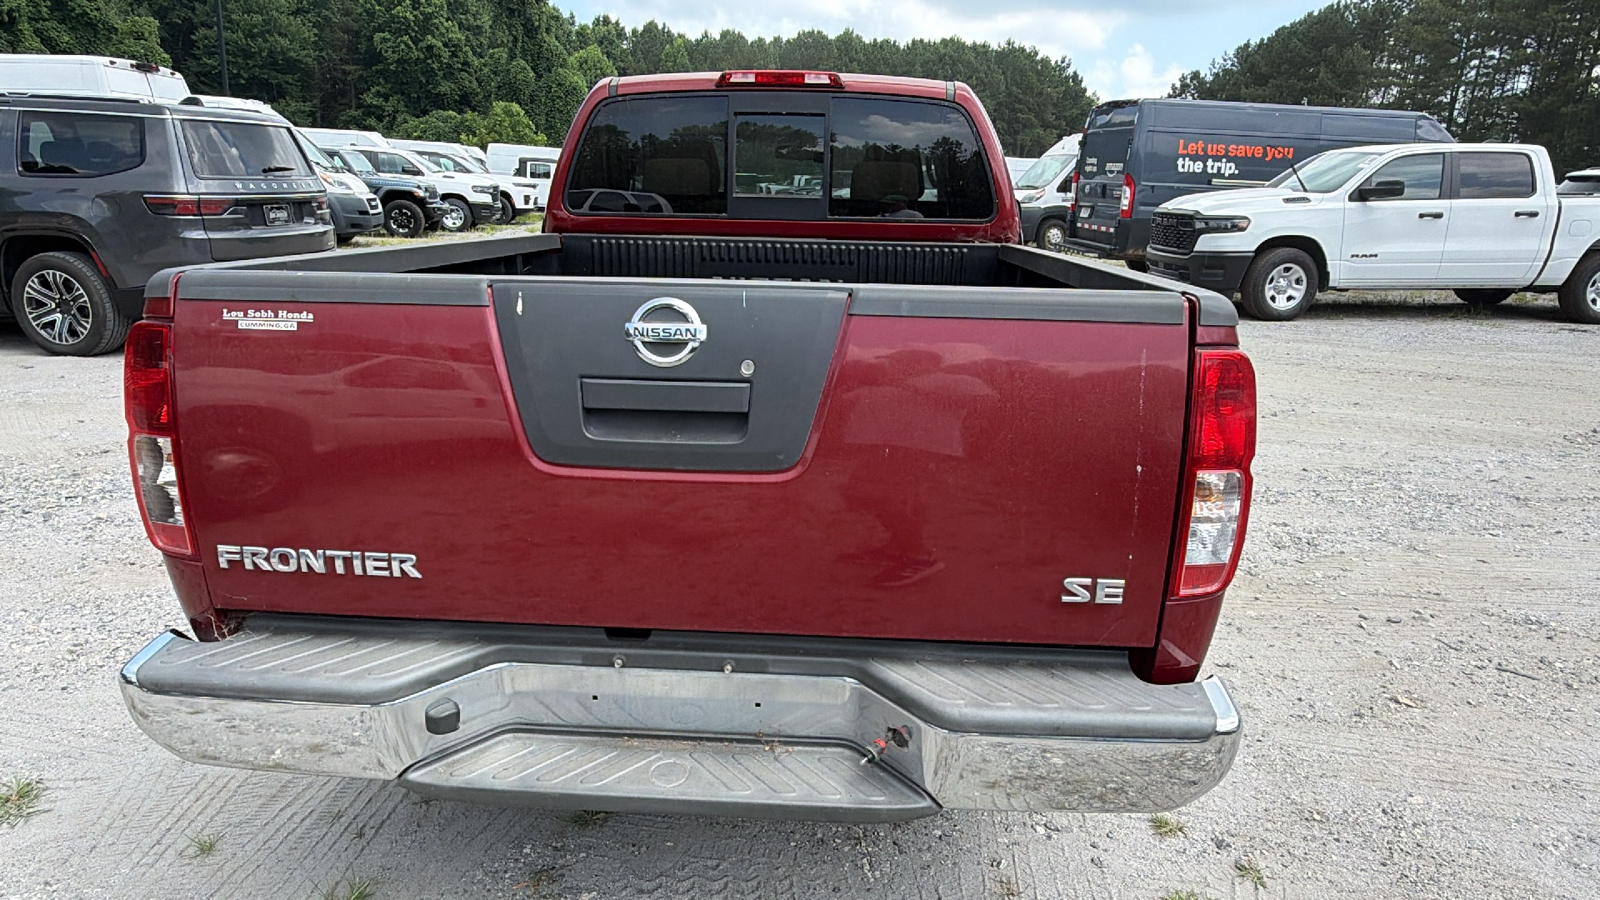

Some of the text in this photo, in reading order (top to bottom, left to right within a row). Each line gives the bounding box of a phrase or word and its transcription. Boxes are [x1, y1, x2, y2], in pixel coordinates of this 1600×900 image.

[1178, 139, 1293, 161] Let us save you
[1177, 157, 1239, 177] the trip.
[222, 308, 314, 319] Lou Sobh Honda
[633, 326, 698, 338] NISSAN
[217, 544, 422, 579] FRONTIER
[1061, 577, 1125, 604] SE
